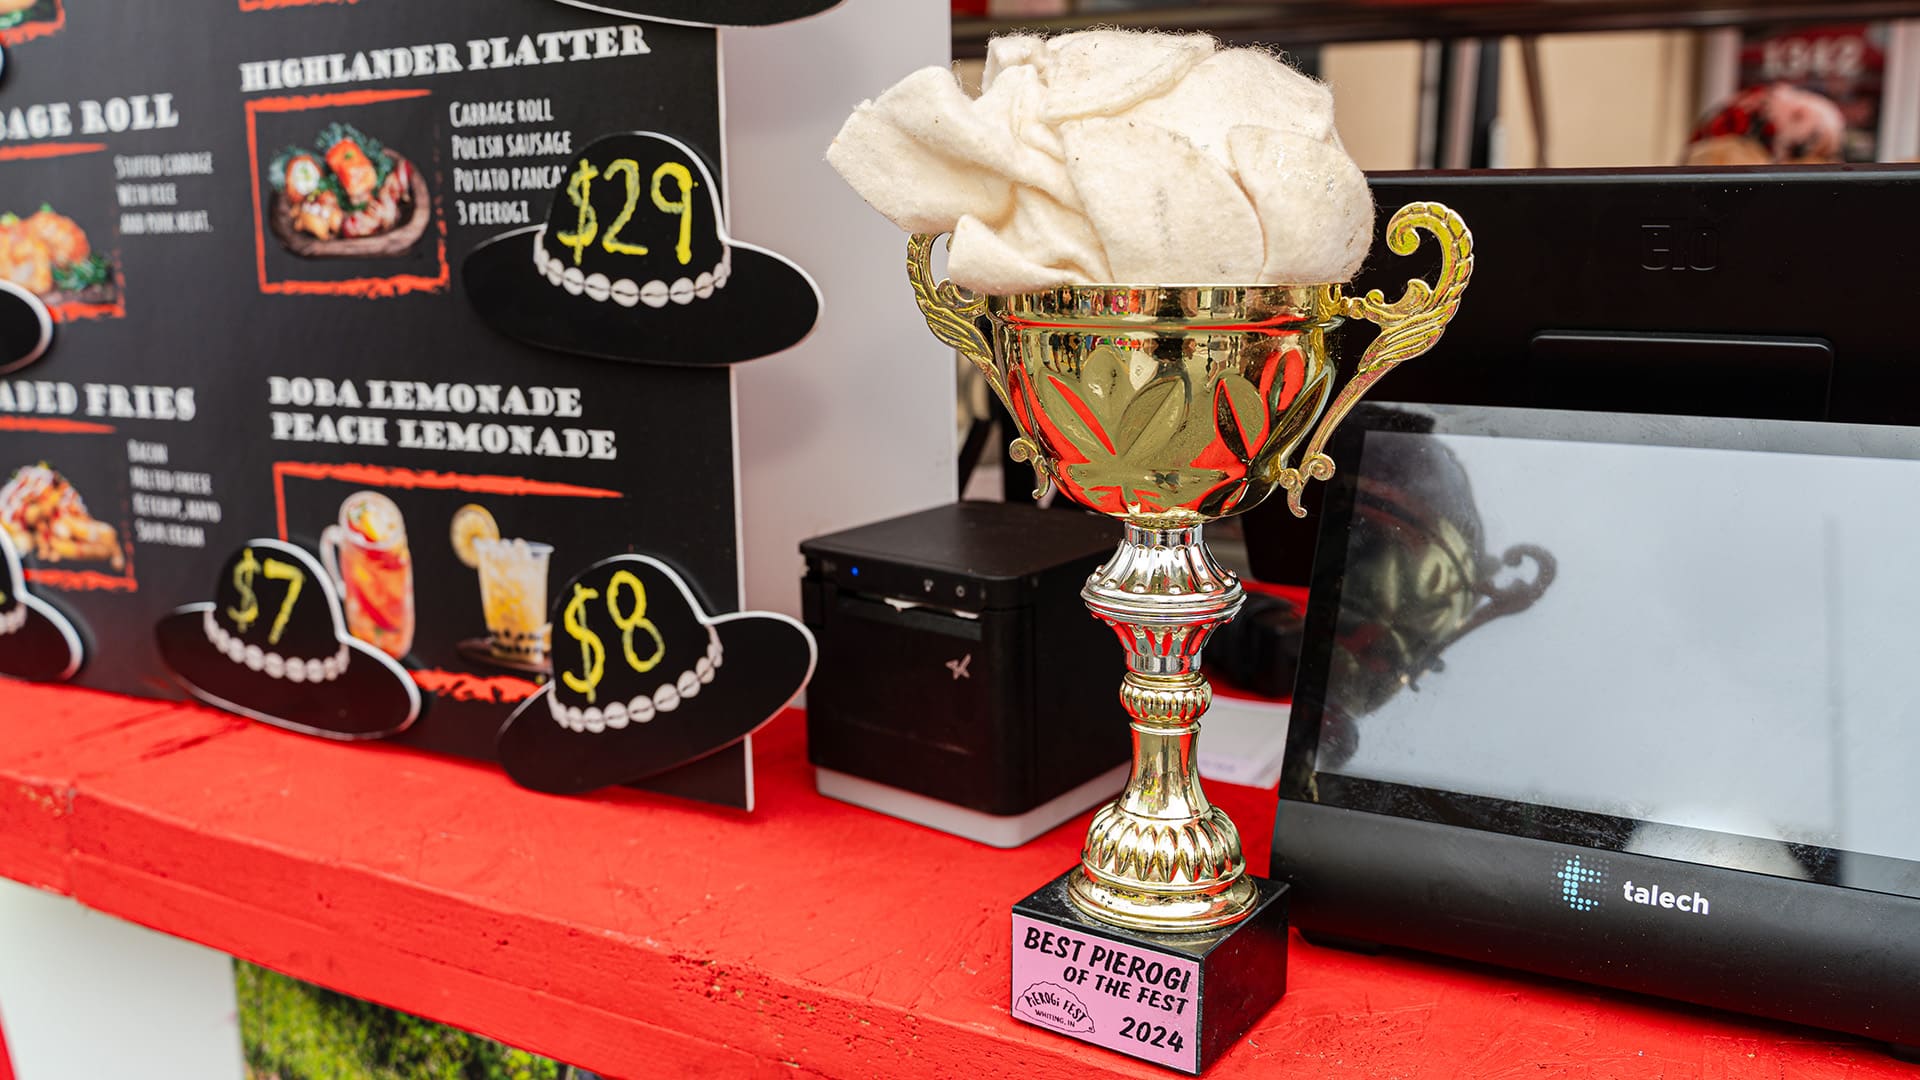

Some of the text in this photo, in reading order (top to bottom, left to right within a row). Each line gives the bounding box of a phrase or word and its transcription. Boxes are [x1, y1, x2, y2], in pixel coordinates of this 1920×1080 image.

[239, 25, 651, 92] HIGHLANDER PLATTER
[0, 92, 179, 141] AGE ROLL
[511, 165, 568, 191] PANCA
[455, 200, 468, 226] 3
[557, 157, 697, 266] $29
[83, 382, 196, 422] FRIES
[269, 376, 582, 419] BOBA LEMONADE
[270, 411, 617, 461] PEACH LEMONADE
[227, 547, 307, 646] $7
[562, 570, 666, 704] $8
[1623, 880, 1710, 915] talech
[1024, 927, 1192, 993] BEST PIEROGI
[1063, 965, 1189, 1015] OF THE FEST
[1063, 1000, 1087, 1023] FEST
[1034, 1009, 1076, 1028] WHITING, IN
[1119, 1016, 1184, 1053] 2024
